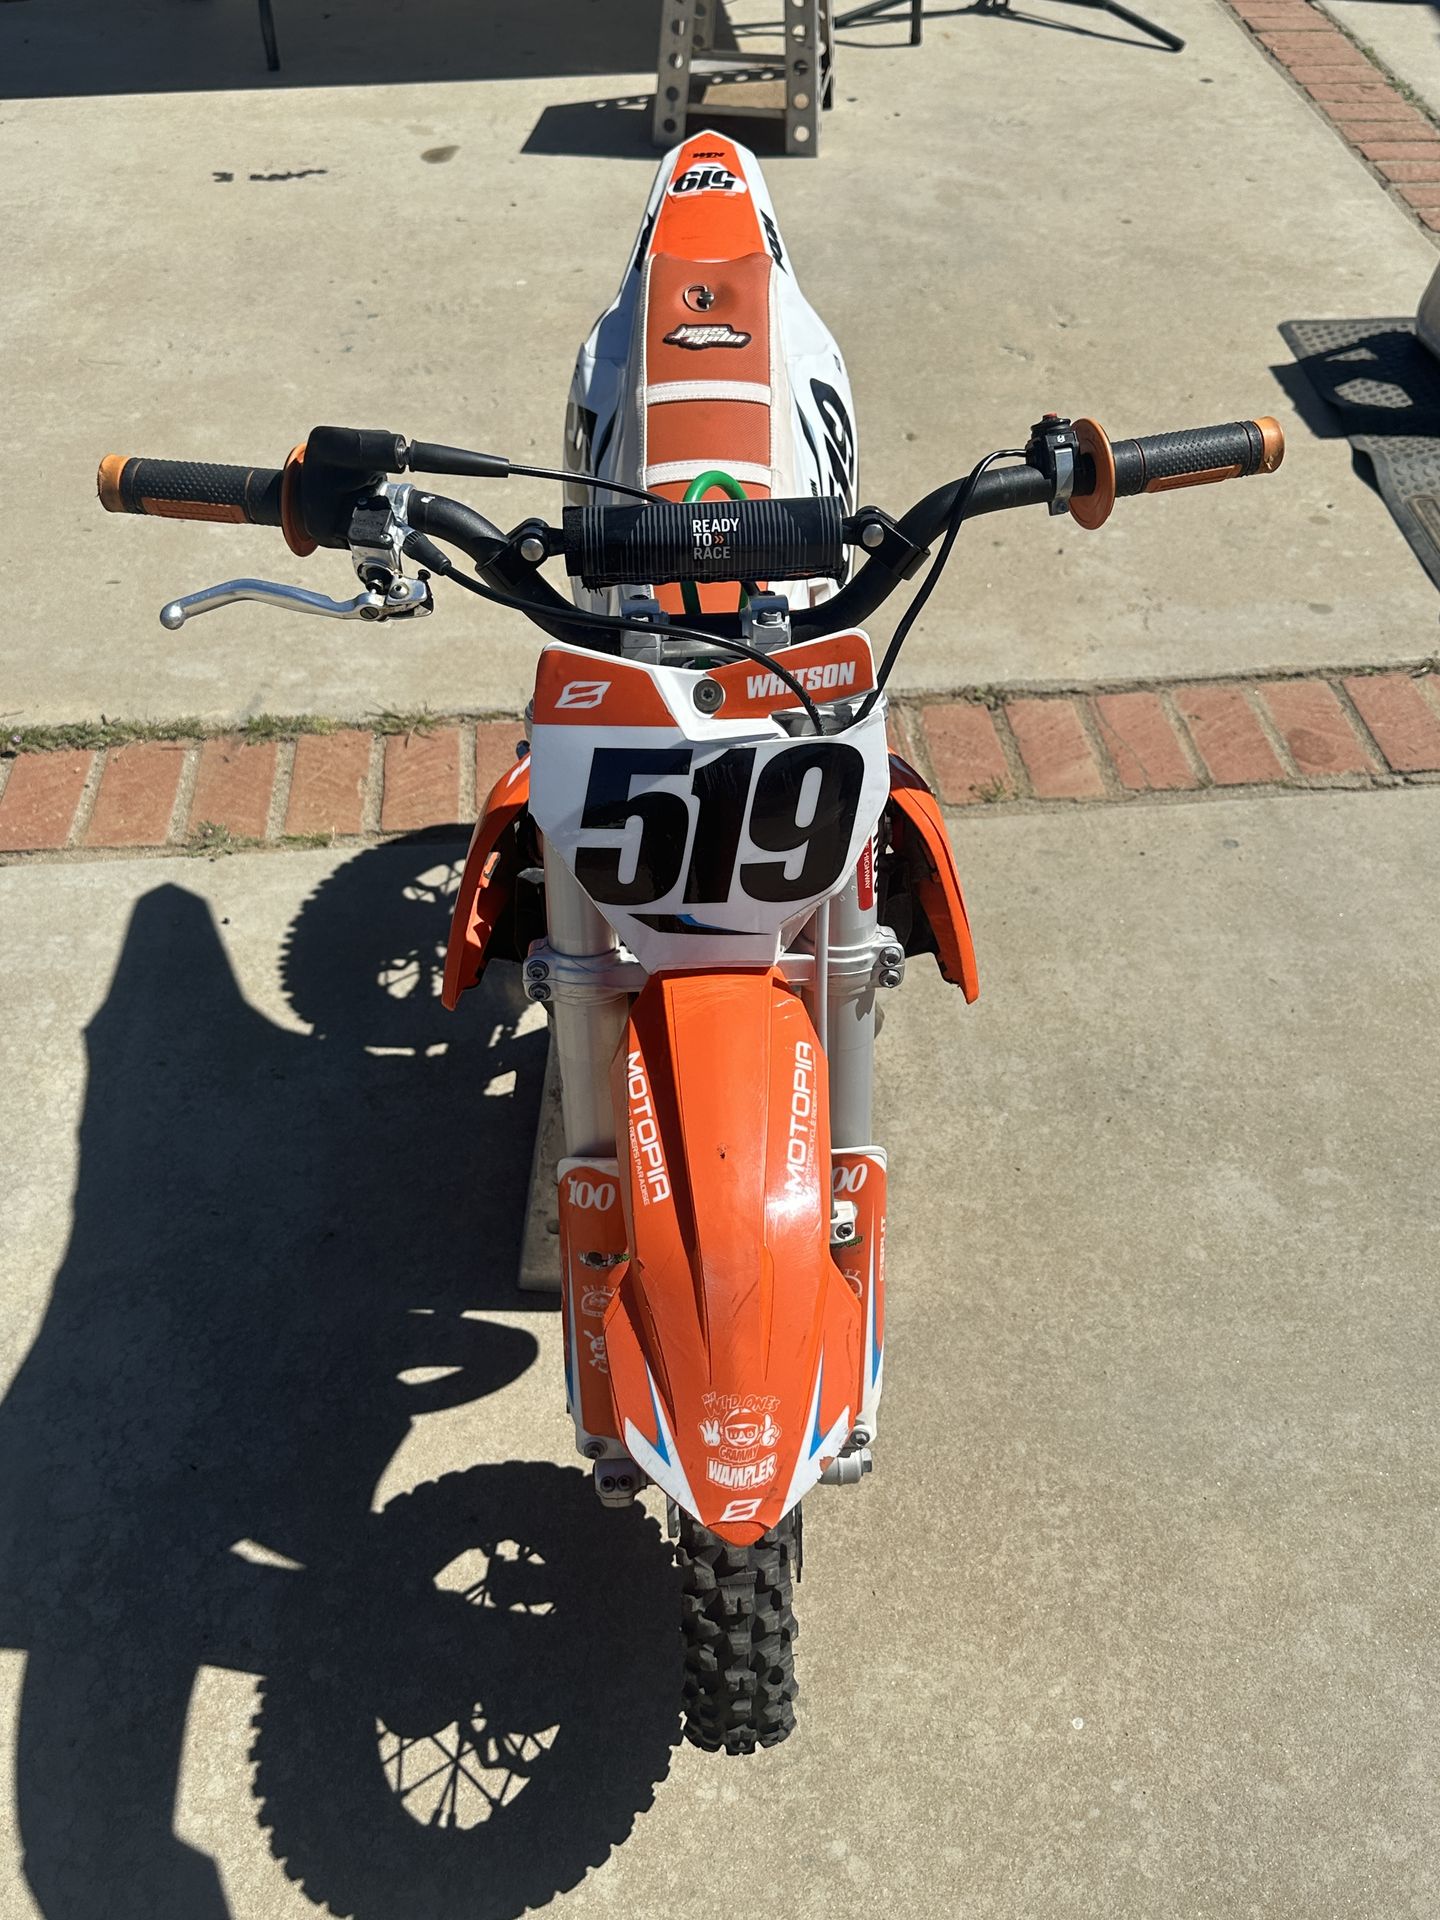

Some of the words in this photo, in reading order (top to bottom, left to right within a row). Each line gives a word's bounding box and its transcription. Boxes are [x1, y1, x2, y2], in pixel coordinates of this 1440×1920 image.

[672, 170, 736, 193] 519
[692, 517, 739, 534] READY
[693, 533, 712, 547] TO
[693, 546, 731, 560] RACE
[575, 742, 865, 905] 519
[627, 1050, 671, 1203] MOTOPIA
[786, 1041, 813, 1193] MOTOPIA
[628, 1126, 641, 1159] RIDERS
[634, 1158, 650, 1206] PARADISE
[832, 1163, 868, 1193] 00
[568, 1177, 616, 1211] 100
[742, 1393, 781, 1413] ONES
[719, 1444, 760, 1462] GRAMMY
[707, 1454, 777, 1488] WAMPLER
